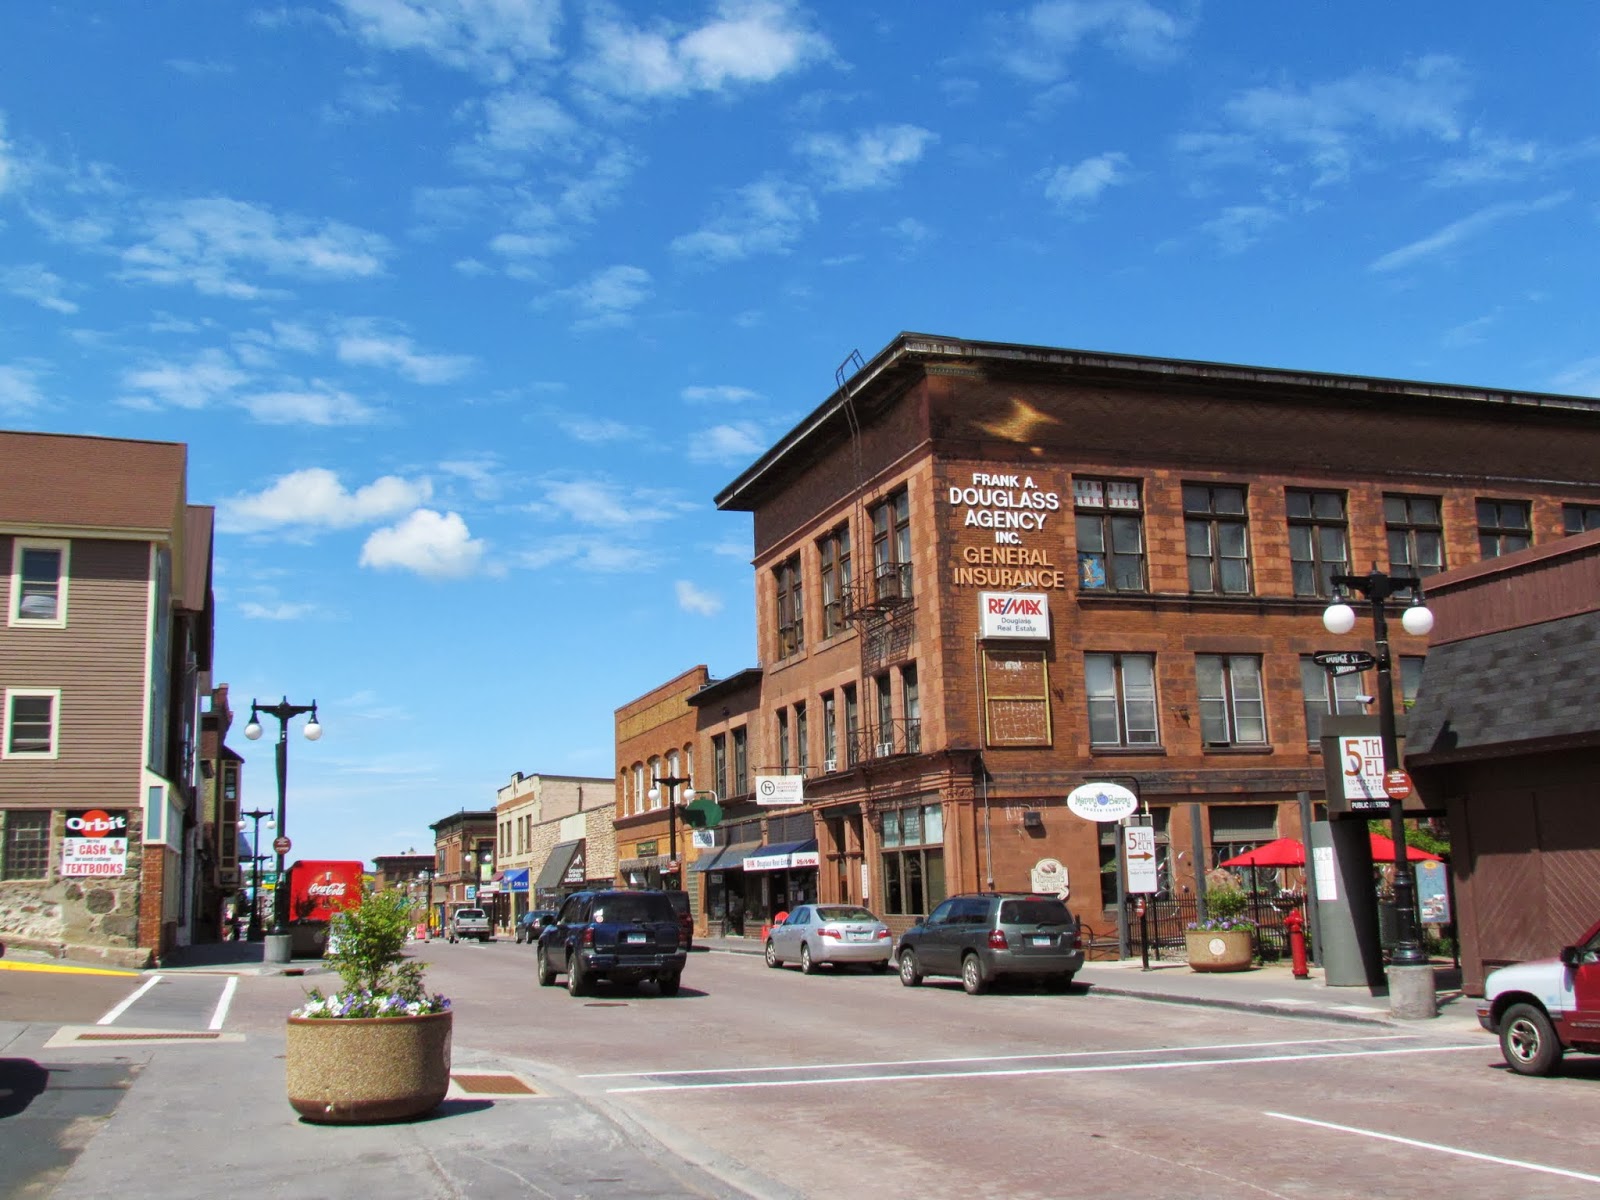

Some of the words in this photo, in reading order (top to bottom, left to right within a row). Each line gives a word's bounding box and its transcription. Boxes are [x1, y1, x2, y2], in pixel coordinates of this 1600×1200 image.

[972, 473, 1019, 487] FRANK
[1024, 476, 1038, 488] A.
[949, 487, 1059, 510] DOUGLASS
[965, 509, 1047, 530] AGENCY
[995, 531, 1022, 544] INC.
[963, 546, 1054, 567] GENERAL
[954, 567, 1064, 588] INSURANCE
[988, 598, 1043, 615] RE/MAX
[1001, 617, 1032, 625] Douglass
[1364, 760, 1383, 776] EL
[1351, 801, 1369, 809] PUBLIC
[66, 816, 126, 832] Orbit
[79, 844, 107, 855] CASH
[65, 863, 123, 874] TEXTBOOKS
